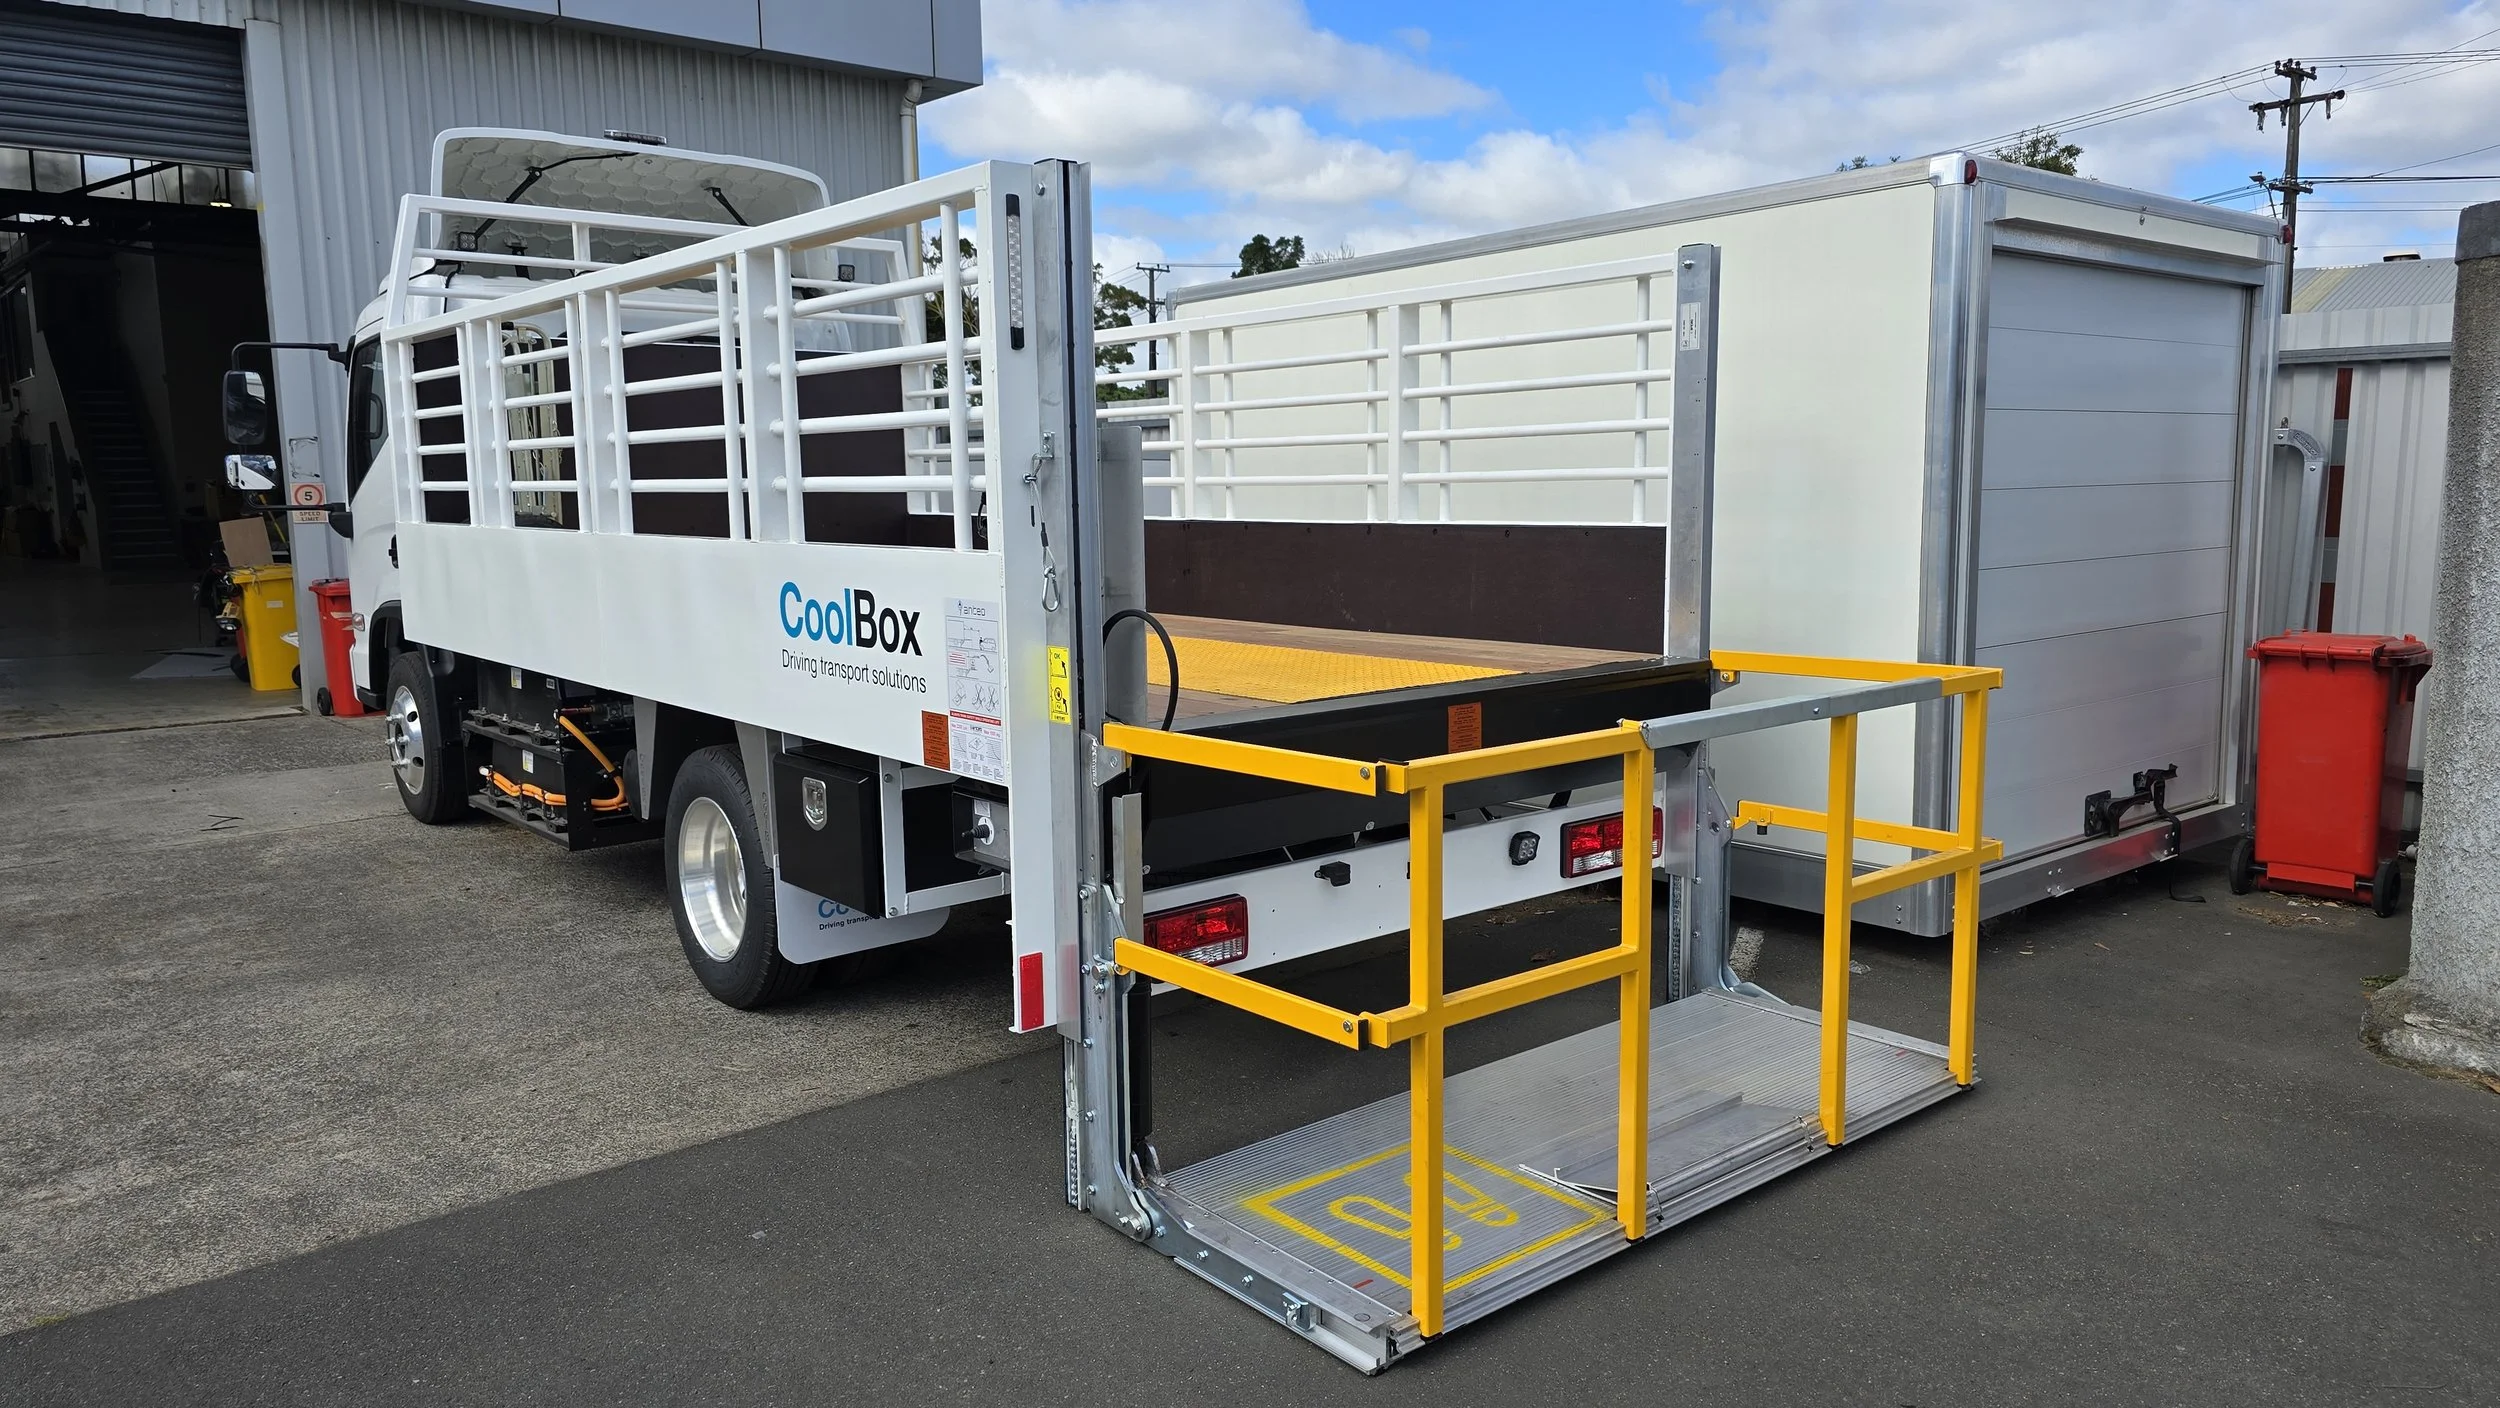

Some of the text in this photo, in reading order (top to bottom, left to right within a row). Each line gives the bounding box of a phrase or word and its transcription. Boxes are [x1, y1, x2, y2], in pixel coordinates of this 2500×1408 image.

[304, 491, 312, 501] 5
[779, 581, 923, 657] CoolBox
[782, 649, 927, 694] Driving transport solutions
[819, 920, 845, 930] Driving
